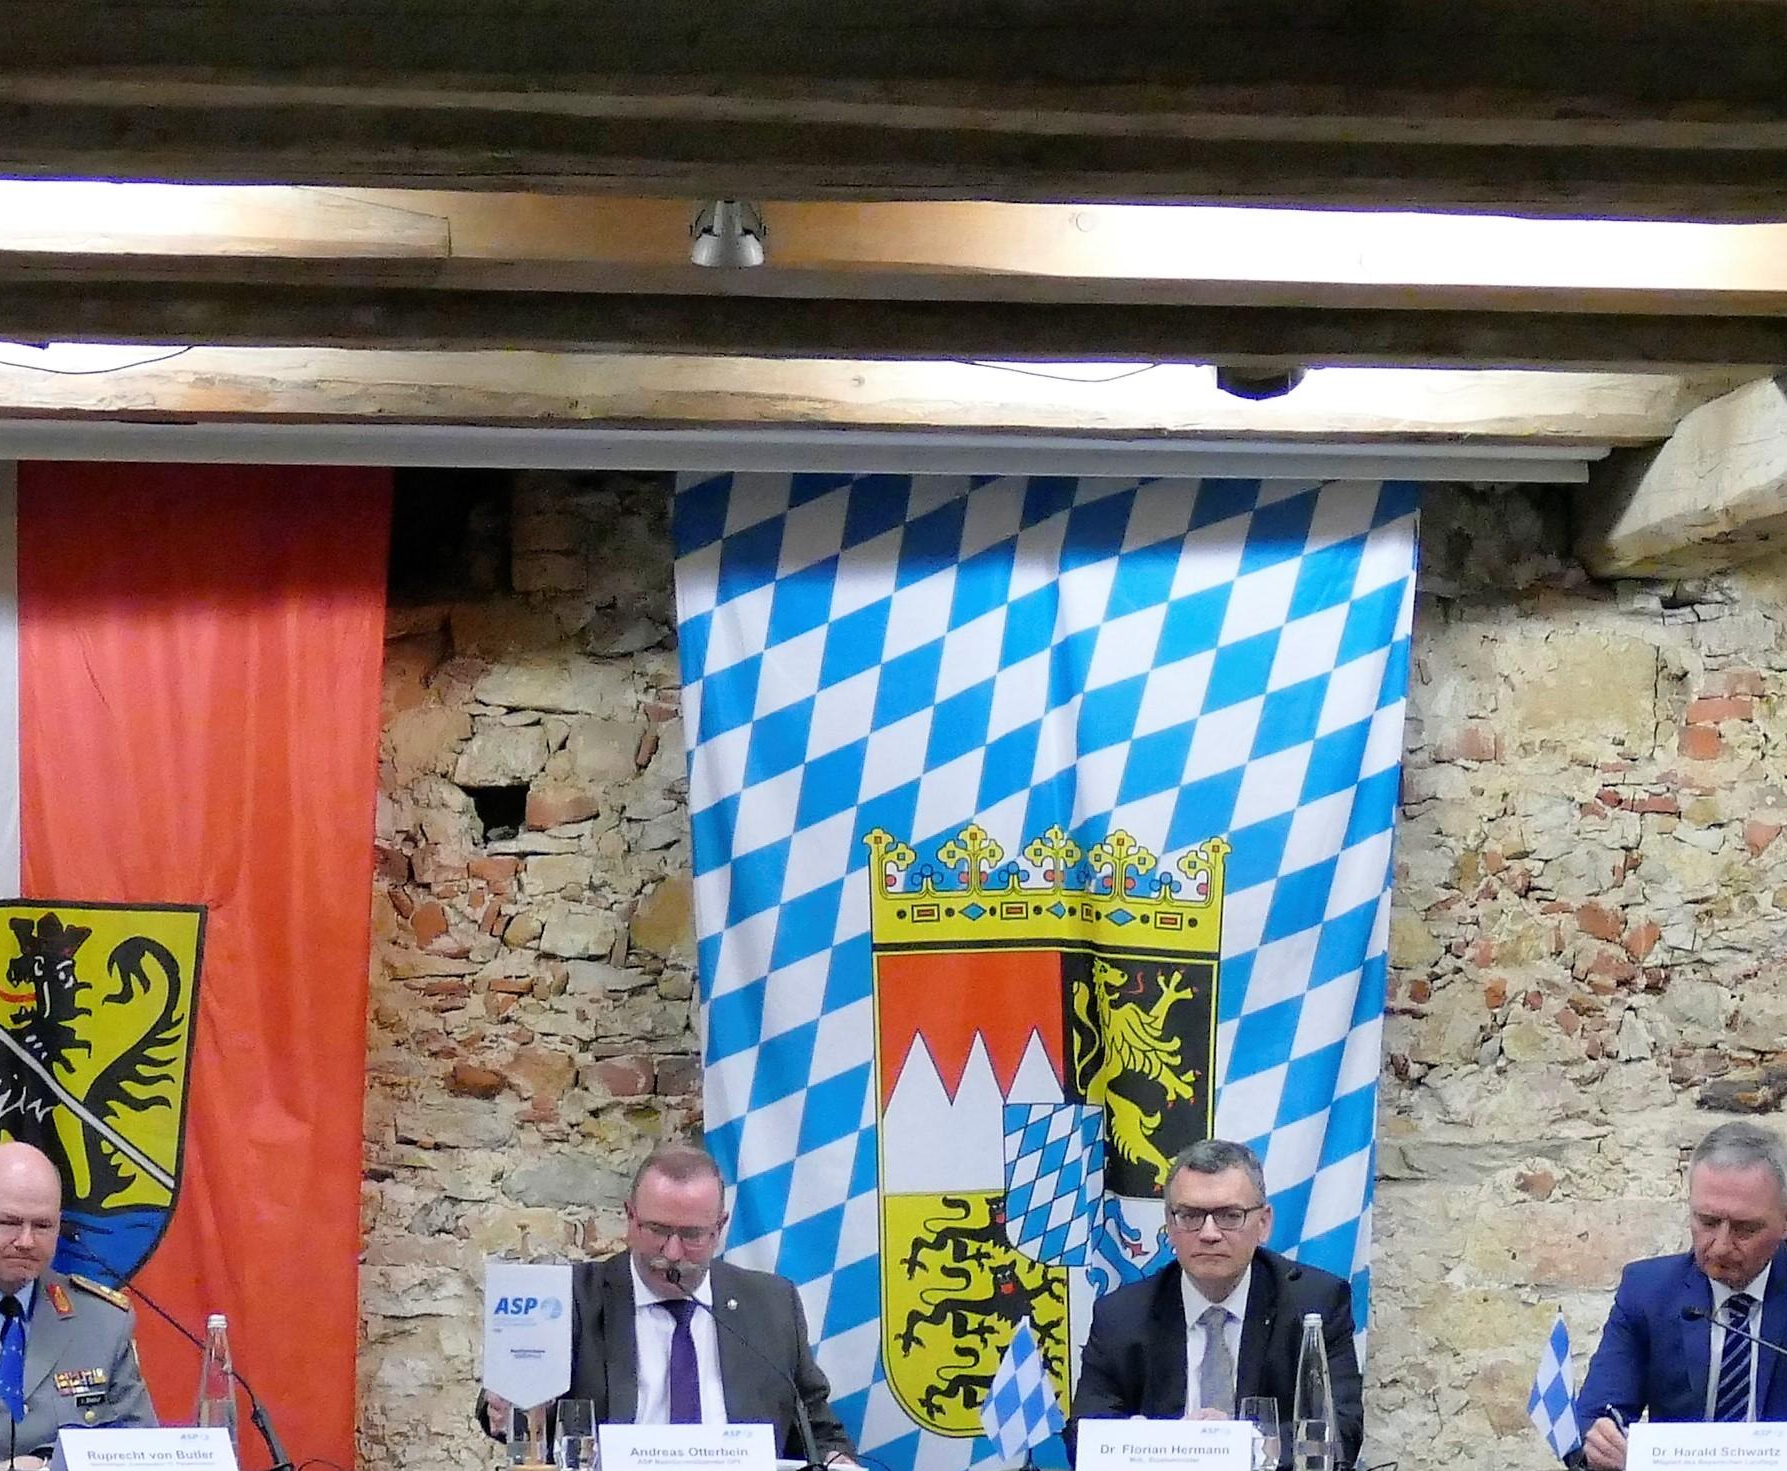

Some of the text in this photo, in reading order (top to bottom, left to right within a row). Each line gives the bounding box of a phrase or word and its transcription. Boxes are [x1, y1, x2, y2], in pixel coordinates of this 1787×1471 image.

[493, 1297, 538, 1315] ASP
[630, 1447, 749, 1457] Andreas Otterbein
[1122, 1444, 1167, 1455] Florian
[1171, 1444, 1230, 1455] Hermann
[1674, 1447, 1717, 1457] Harald
[1721, 1446, 1781, 1457] Schwartz
[87, 1450, 214, 1462] Ruprecht von Butler
